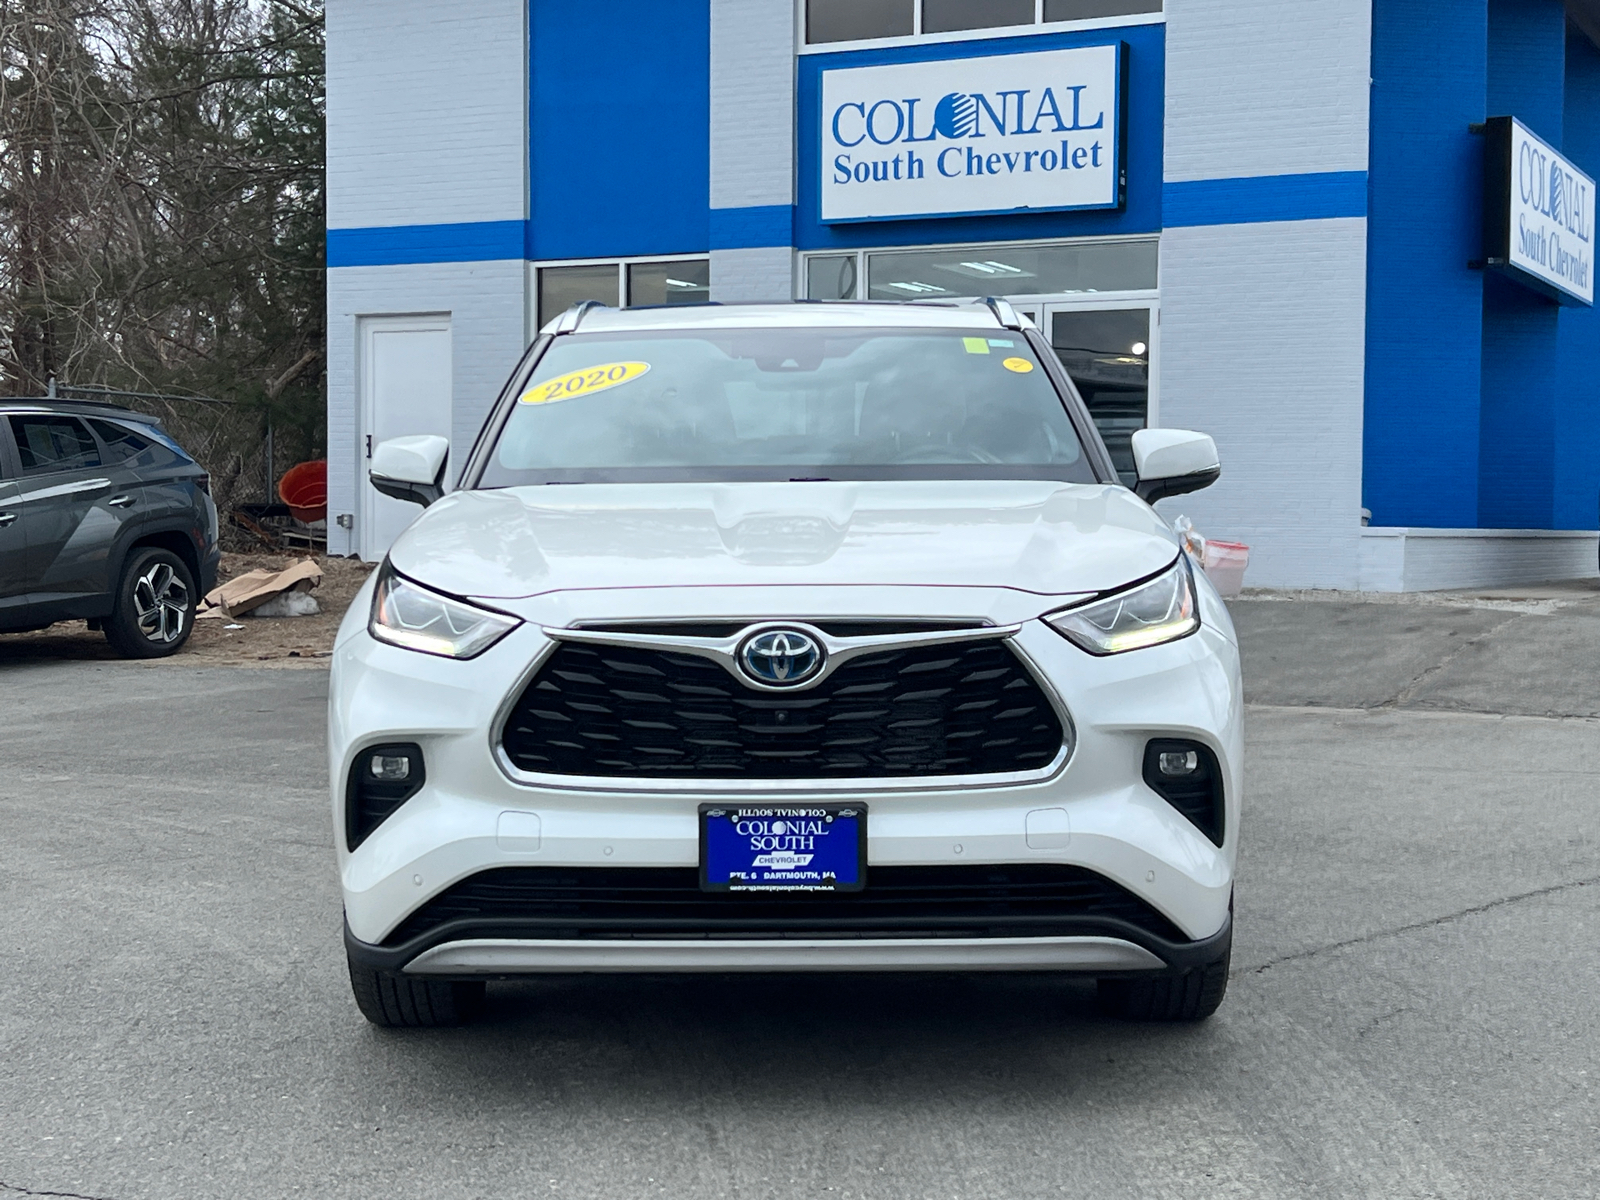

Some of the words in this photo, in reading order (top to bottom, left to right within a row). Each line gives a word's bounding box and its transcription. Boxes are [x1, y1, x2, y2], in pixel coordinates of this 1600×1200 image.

[832, 85, 1104, 147] COLONIAL
[833, 151, 924, 185] South
[937, 140, 1103, 177] Chevrolet
[1519, 140, 1589, 243] COLONIAL
[1519, 212, 1547, 268] South
[1549, 231, 1589, 291] Chevrolet
[545, 365, 627, 401] 2020
[738, 808, 773, 818] SOUTH
[736, 820, 829, 836] COLONIAL
[750, 836, 815, 851] SOUTH
[758, 856, 807, 864] CHEVROLET
[763, 871, 820, 880] DARTMOUTH,
